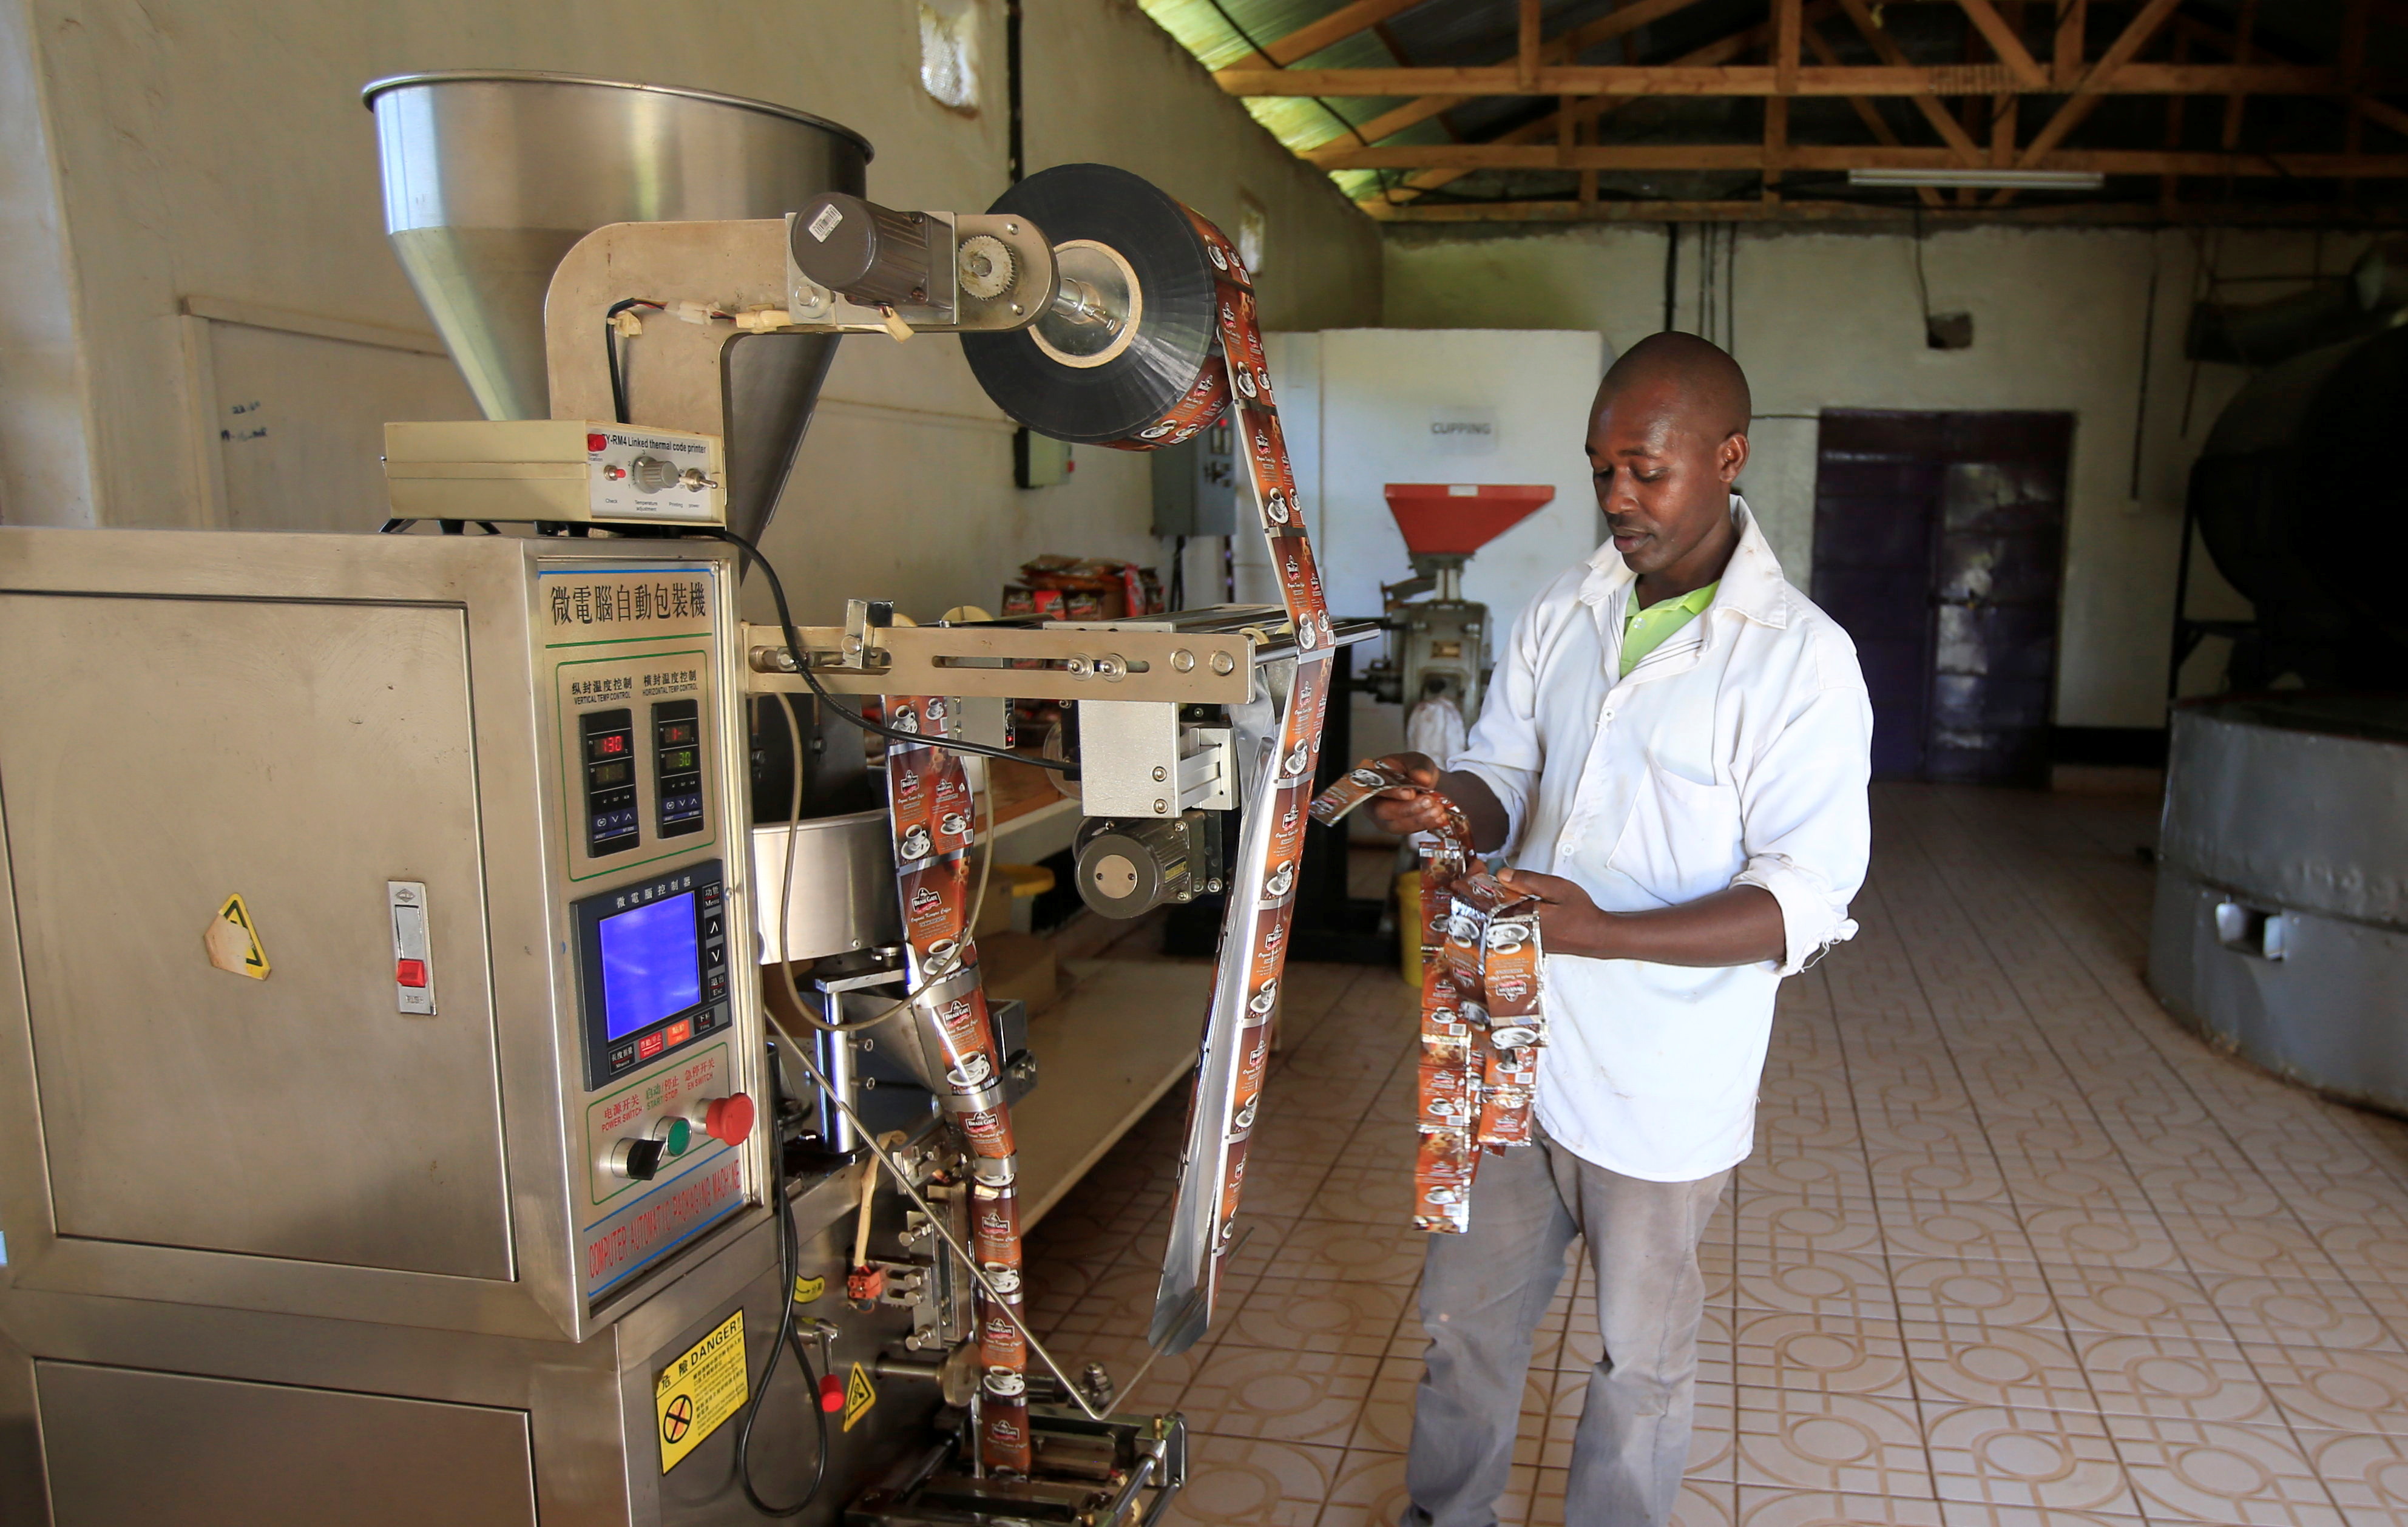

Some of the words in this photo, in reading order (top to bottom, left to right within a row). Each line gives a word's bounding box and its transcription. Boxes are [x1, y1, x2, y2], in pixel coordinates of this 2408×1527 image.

[1430, 422, 1492, 435] CUPPING
[628, 437, 649, 449] Linked
[649, 439, 671, 451] thermal
[672, 442, 686, 452] code
[688, 444, 706, 455] printer
[550, 581, 706, 626] 微電腦自動包裝機
[572, 676, 632, 695] 纵封温度控制
[644, 669, 697, 687] 横封温度控制
[573, 694, 597, 705] VERTICAL
[598, 693, 610, 702] TEMP
[610, 691, 631, 701] CONTROL
[642, 686, 668, 697] HORIZONTAL
[669, 685, 680, 694] TEMP
[680, 683, 698, 692] CONTROL
[603, 736, 623, 753] 130
[705, 885, 720, 896] 功能
[705, 899, 720, 907] Menu
[685, 1058, 715, 1082] 急停开关
[695, 1072, 714, 1088] SWITCH
[604, 1094, 639, 1119] 电源开关
[647, 1095, 664, 1111] START
[601, 1119, 622, 1133] POWER
[623, 1106, 643, 1123] SWITCH
[589, 1225, 628, 1278] COMPUTER
[671, 1176, 712, 1222] PACKAGING
[712, 1159, 740, 1202] MACHINE
